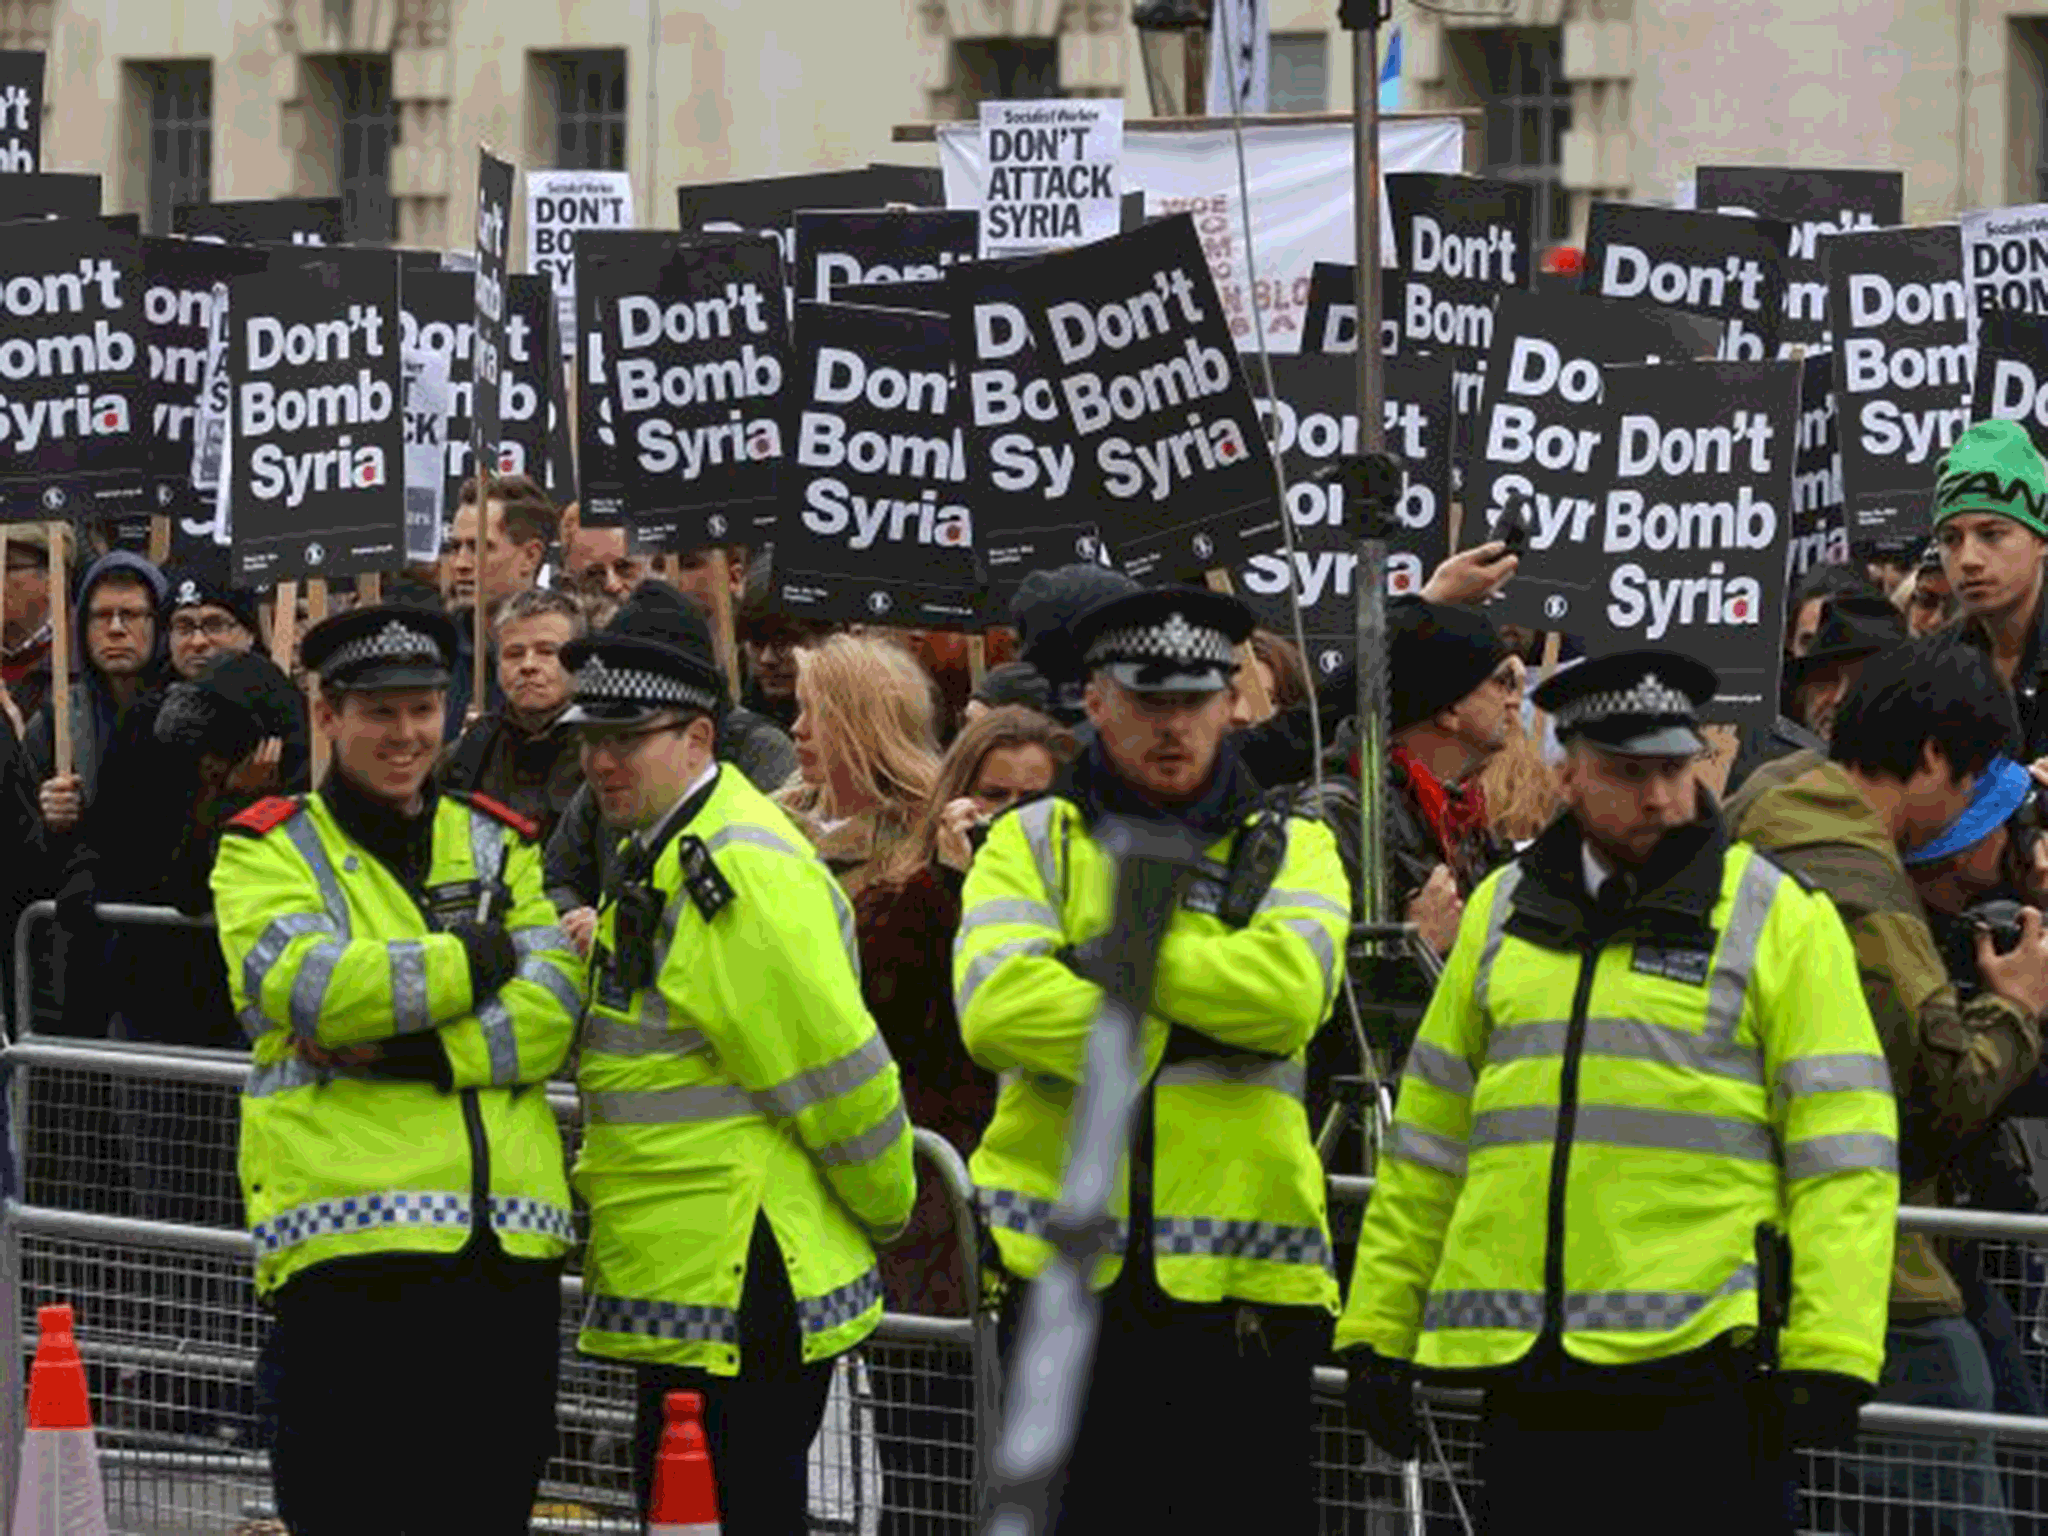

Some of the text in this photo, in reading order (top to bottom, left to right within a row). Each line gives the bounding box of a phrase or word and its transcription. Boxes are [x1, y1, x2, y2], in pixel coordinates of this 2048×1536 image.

[989, 127, 1091, 162] DON'T
[536, 197, 624, 224] DON'T
[987, 165, 1113, 201] ATTACK
[536, 229, 576, 254] BO
[987, 204, 1083, 239] SYRIA
[1413, 215, 1516, 285] Don't
[0, 258, 124, 316] on't
[1602, 244, 1764, 310] Don't
[1973, 238, 2048, 278] DON
[618, 283, 768, 349] Don't
[1046, 268, 1204, 365] Don't
[1407, 283, 1495, 349] Bom
[1849, 274, 1965, 328] Don
[0, 320, 136, 379] omb
[246, 305, 384, 371] Don't
[1845, 338, 1977, 393] Bom
[240, 369, 393, 436] Bomb
[616, 344, 782, 412] Bomb
[971, 370, 1059, 426] Bo
[1061, 338, 1231, 436] Bomb
[637, 409, 782, 480] Syria
[1097, 412, 1250, 501] Syria
[1618, 409, 1775, 477] Don't
[1860, 393, 1972, 463] Syri
[250, 435, 385, 508] Syria
[801, 478, 973, 550] Syria
[1603, 486, 1777, 553] Bomb
[1607, 561, 1760, 639] Syria
